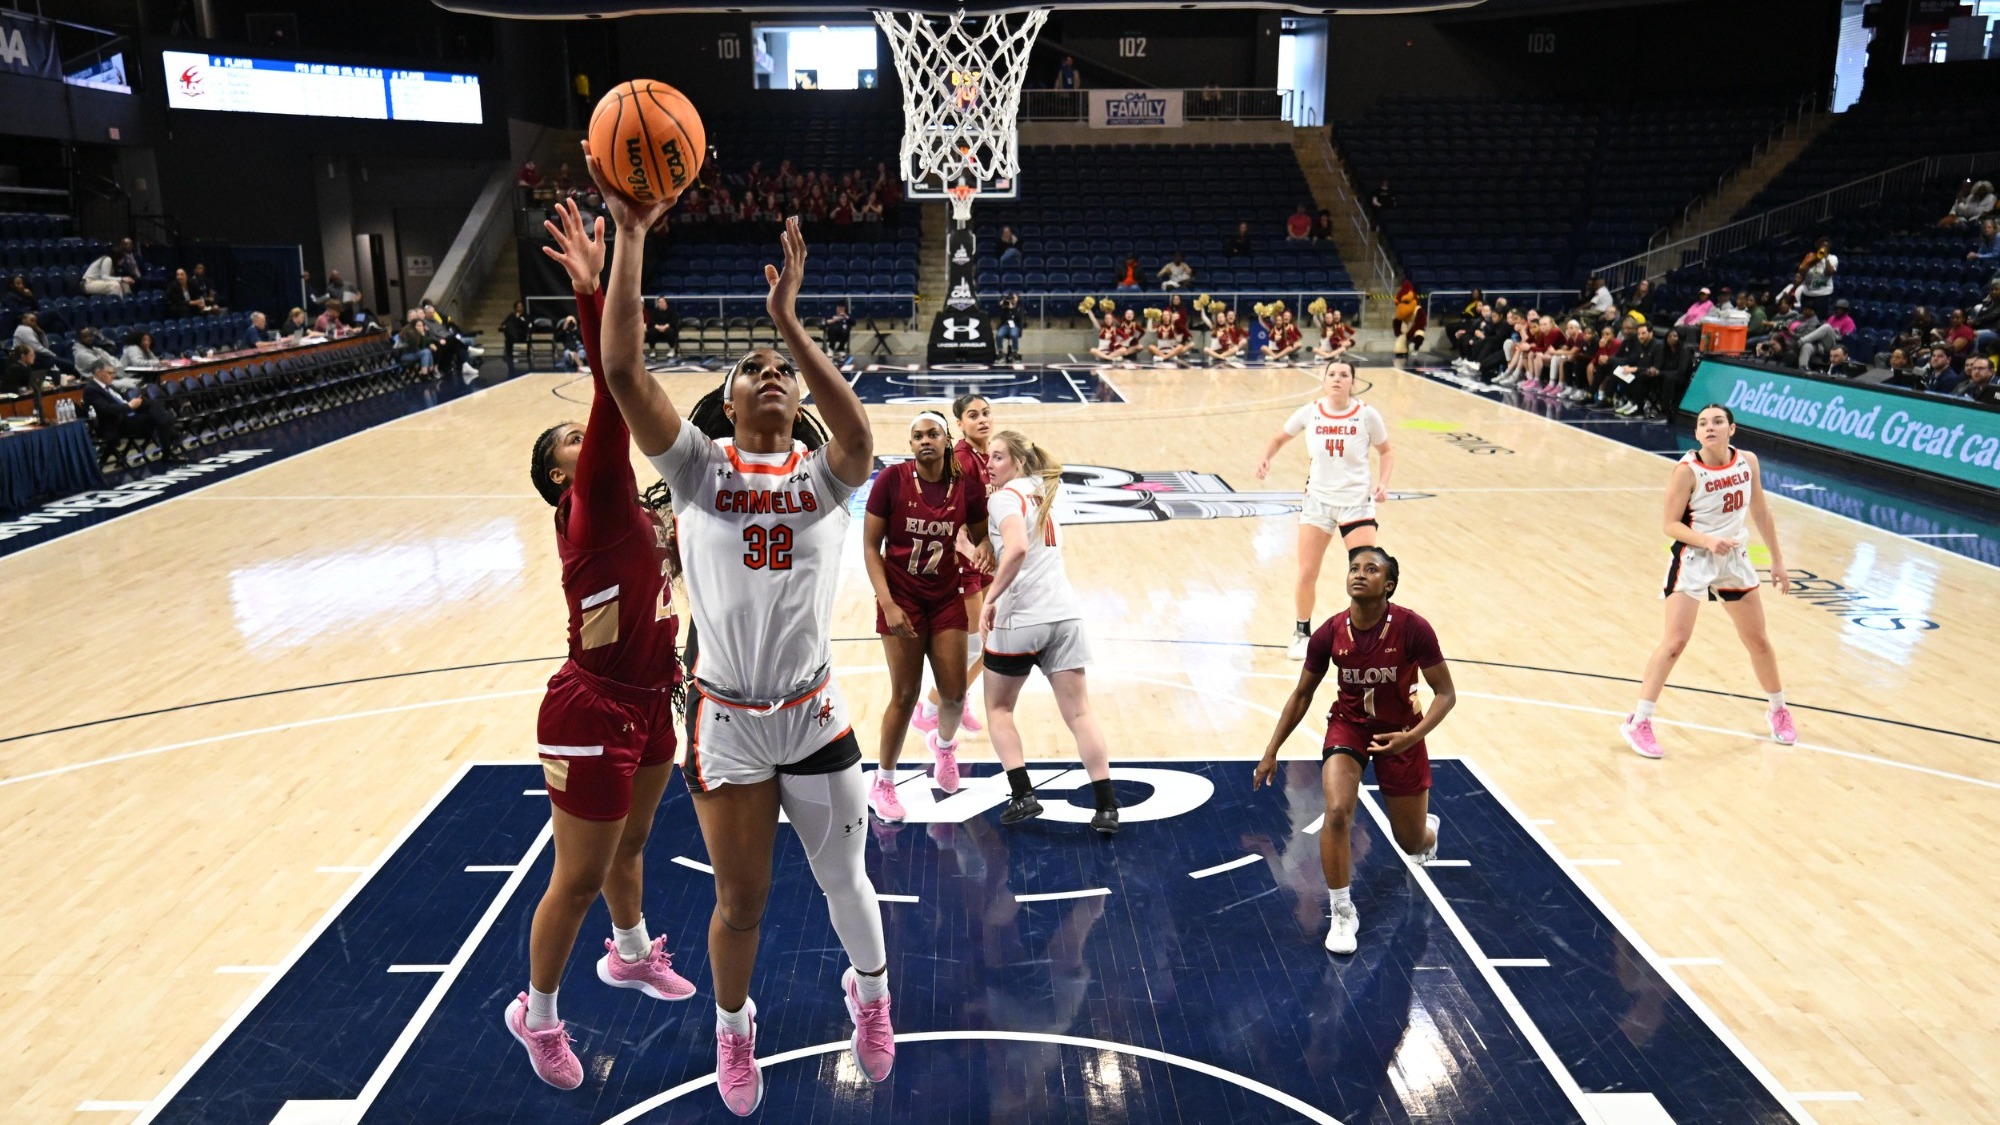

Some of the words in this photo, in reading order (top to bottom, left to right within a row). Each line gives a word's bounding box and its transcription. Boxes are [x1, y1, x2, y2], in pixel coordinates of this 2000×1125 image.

[718, 38, 741, 59] 101
[1119, 38, 1147, 57] 102
[1528, 33, 1556, 53] 103
[1109, 101, 1164, 117] FAMILY
[626, 137, 656, 200] Wilson
[661, 138, 687, 190] NCAA
[1725, 379, 1821, 427] Delicious
[1817, 395, 1882, 440] food.
[1881, 411, 1964, 460] Great
[1315, 425, 1357, 436] CAMELS
[1325, 439, 1344, 457] 44
[789, 472, 810, 483] CAA
[1705, 471, 1750, 493] CAMELS
[715, 489, 818, 514] CAMELS
[1722, 490, 1744, 514] 20
[905, 517, 955, 537] ELON
[742, 523, 794, 571] 32
[906, 538, 944, 576] 12
[1342, 666, 1398, 685] ELON
[1363, 687, 1376, 719] 1
